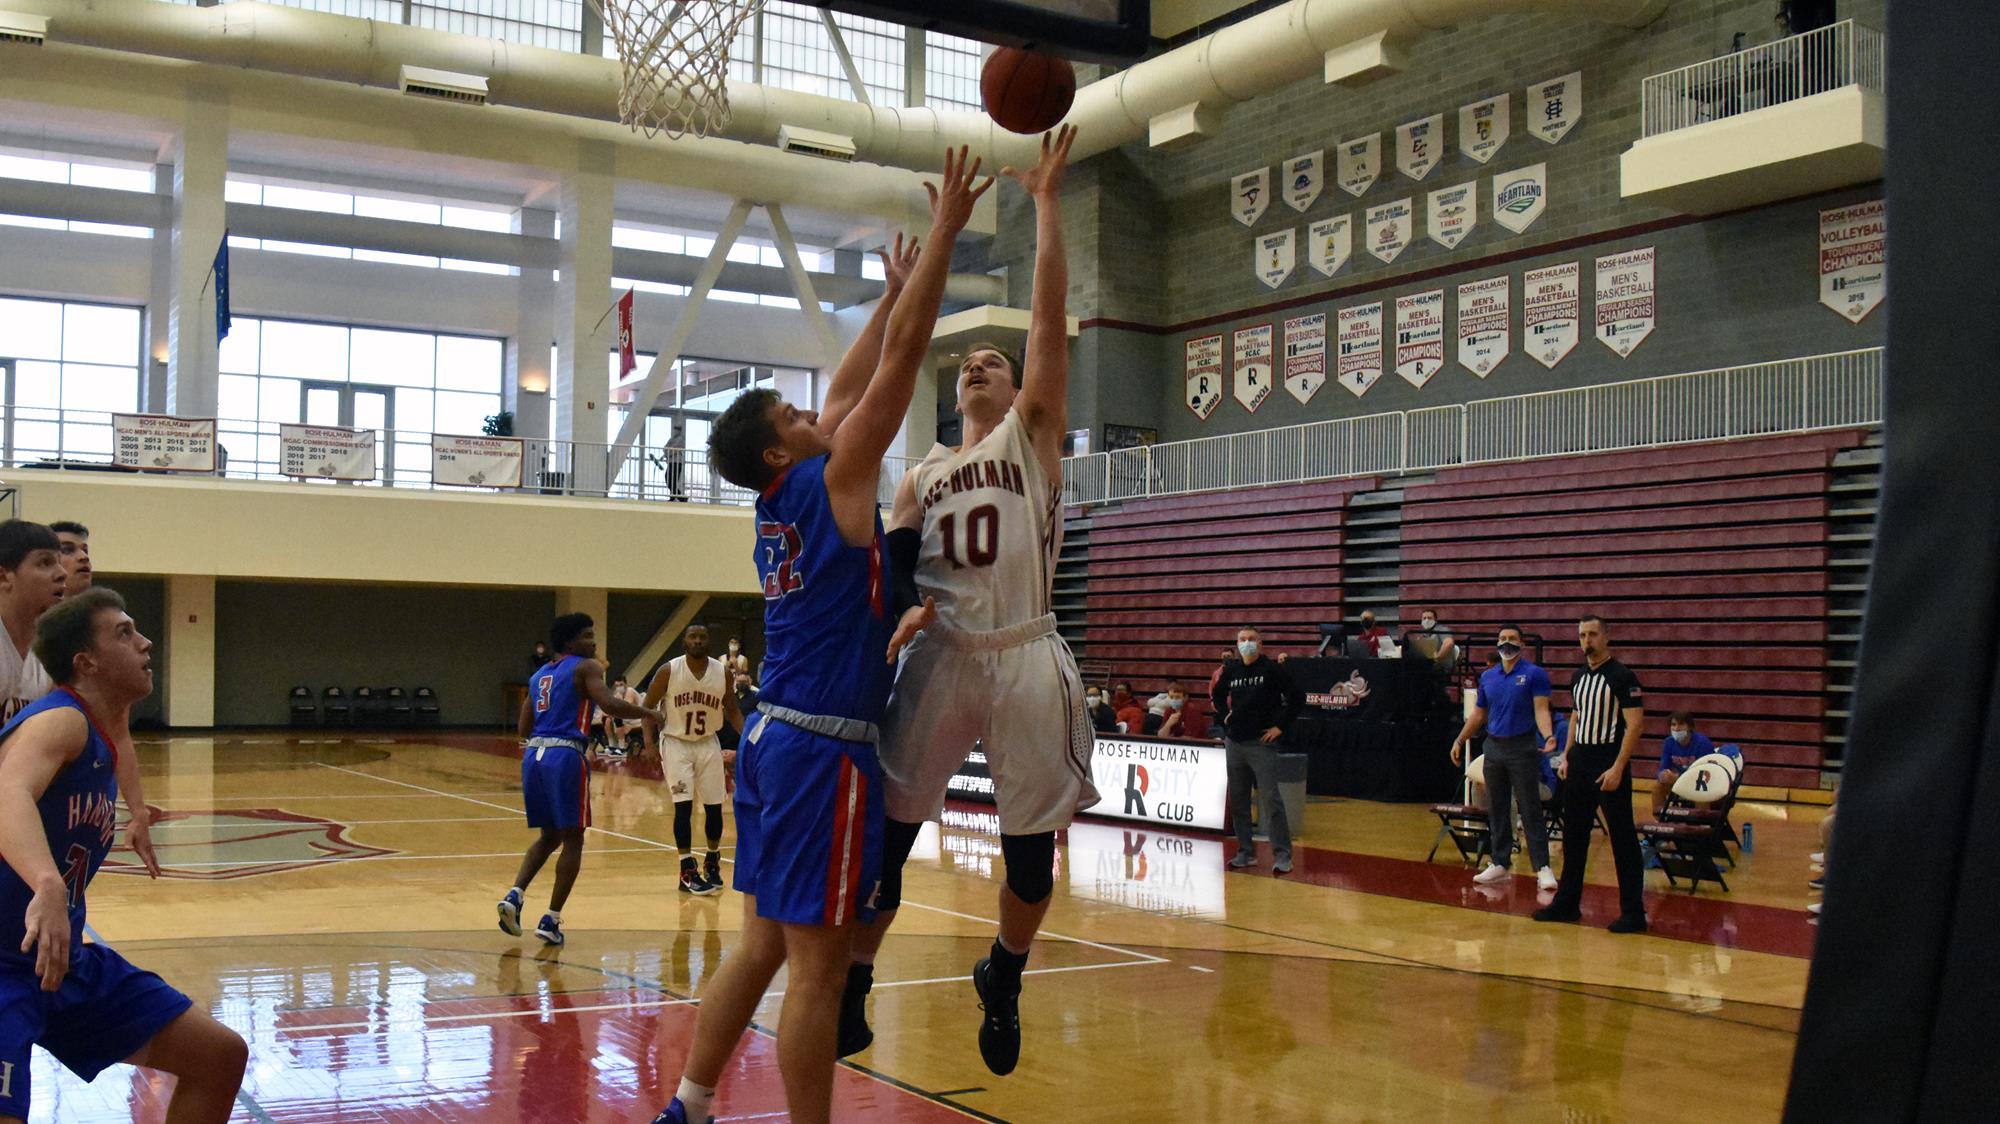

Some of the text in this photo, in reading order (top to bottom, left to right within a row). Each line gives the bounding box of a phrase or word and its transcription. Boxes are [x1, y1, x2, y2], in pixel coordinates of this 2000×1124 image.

[1498, 185, 1541, 207] HEARTLAND
[1822, 204, 1884, 223] ROSE-HULMA
[1821, 222, 1886, 243] VOLLEYBAL
[1828, 242, 1884, 258] TOURNAMEN
[1597, 252, 1652, 270] ROSE-HULMAN
[1823, 251, 1884, 270] CHAMPION
[1526, 265, 1576, 281] ROSE-HULMAN
[1611, 272, 1638, 286] MEN'S
[1460, 280, 1507, 294] ROSE-HULMAN
[1539, 283, 1563, 294] MEN'S
[1597, 282, 1653, 301] BASKETBALL
[1398, 293, 1442, 309] ROSE-HULMAN
[1472, 296, 1494, 307] MEN'S
[1526, 290, 1576, 305] BASKETBALL
[1340, 306, 1380, 320] ROSE-HULMAN
[1409, 309, 1429, 320] MEN'S
[1460, 302, 1506, 318] BASKETBALL
[1527, 308, 1576, 324] CHAMPIONS
[1599, 305, 1651, 323] CHAMPIONS
[1350, 321, 1369, 331] MEN'S
[1398, 316, 1441, 331] BASKETBALL
[1461, 320, 1507, 336] CHAMPIONS
[1340, 327, 1380, 341] BASKETBALL
[1236, 340, 1269, 352] BASKETBALL
[1399, 343, 1441, 361] CHAMPIONS
[1287, 361, 1322, 376] CHAMPIONS
[1340, 359, 1380, 373] CHAMPIONS
[1202, 393, 1219, 415] 1999
[1250, 385, 1269, 407] 2001
[940, 503, 999, 570] 10
[537, 675, 553, 712] 3
[685, 710, 707, 736] 15
[1099, 742, 1200, 763] ROSE-HULMAN
[1695, 769, 1711, 791] R
[1157, 802, 1194, 822] CLUB
